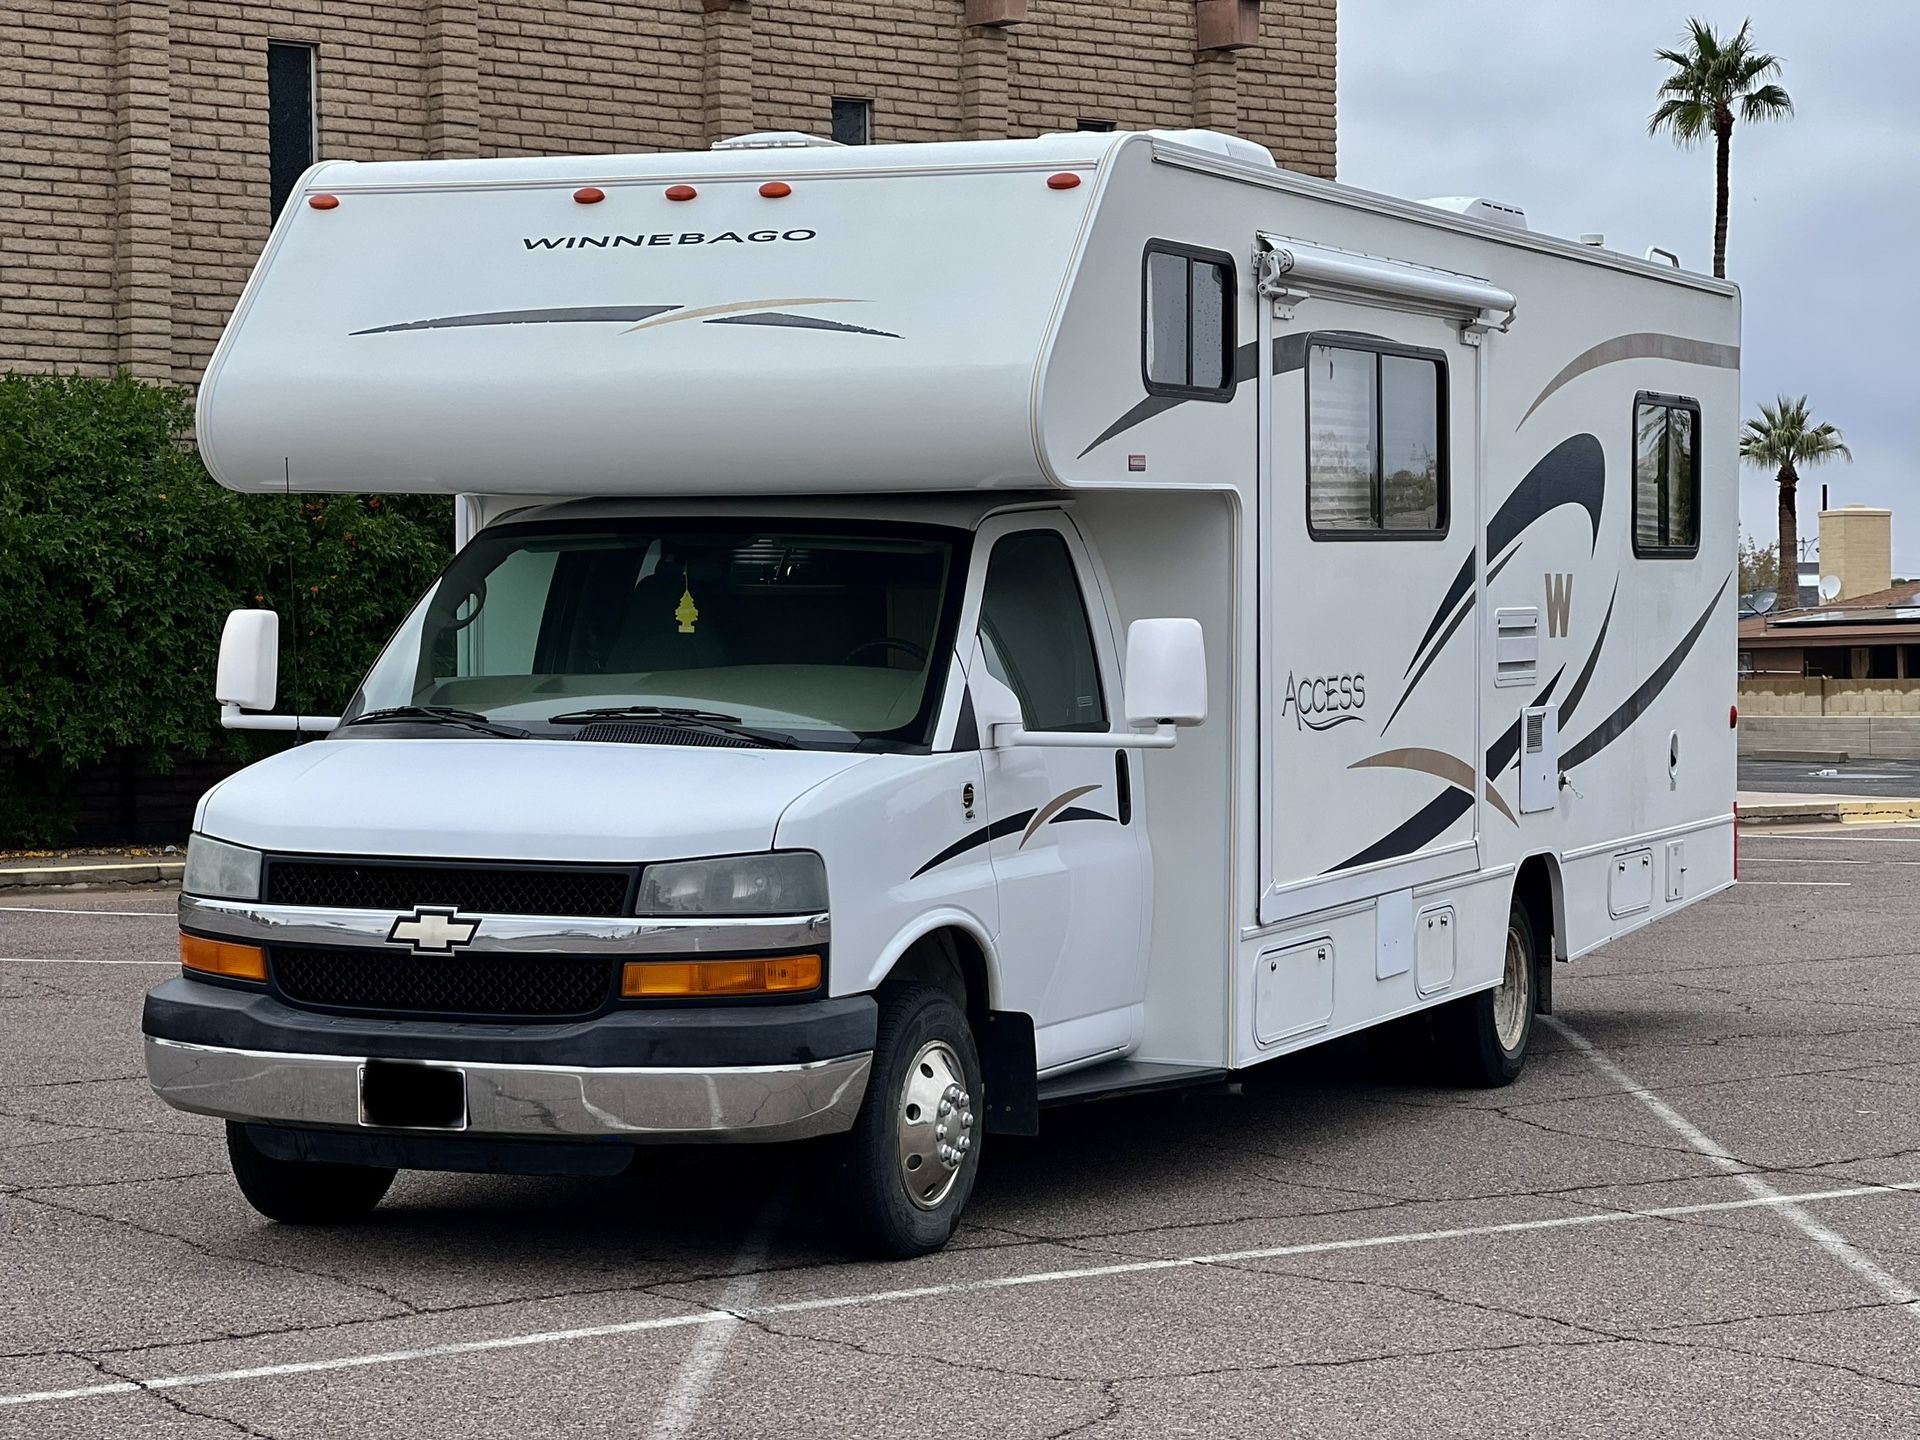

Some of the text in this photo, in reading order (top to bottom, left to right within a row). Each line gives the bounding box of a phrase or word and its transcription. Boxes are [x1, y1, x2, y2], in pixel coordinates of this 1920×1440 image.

[523, 229, 817, 250] WINNEBAGO
[1544, 573, 1573, 638] W
[1282, 670, 1366, 731] ACCESS
